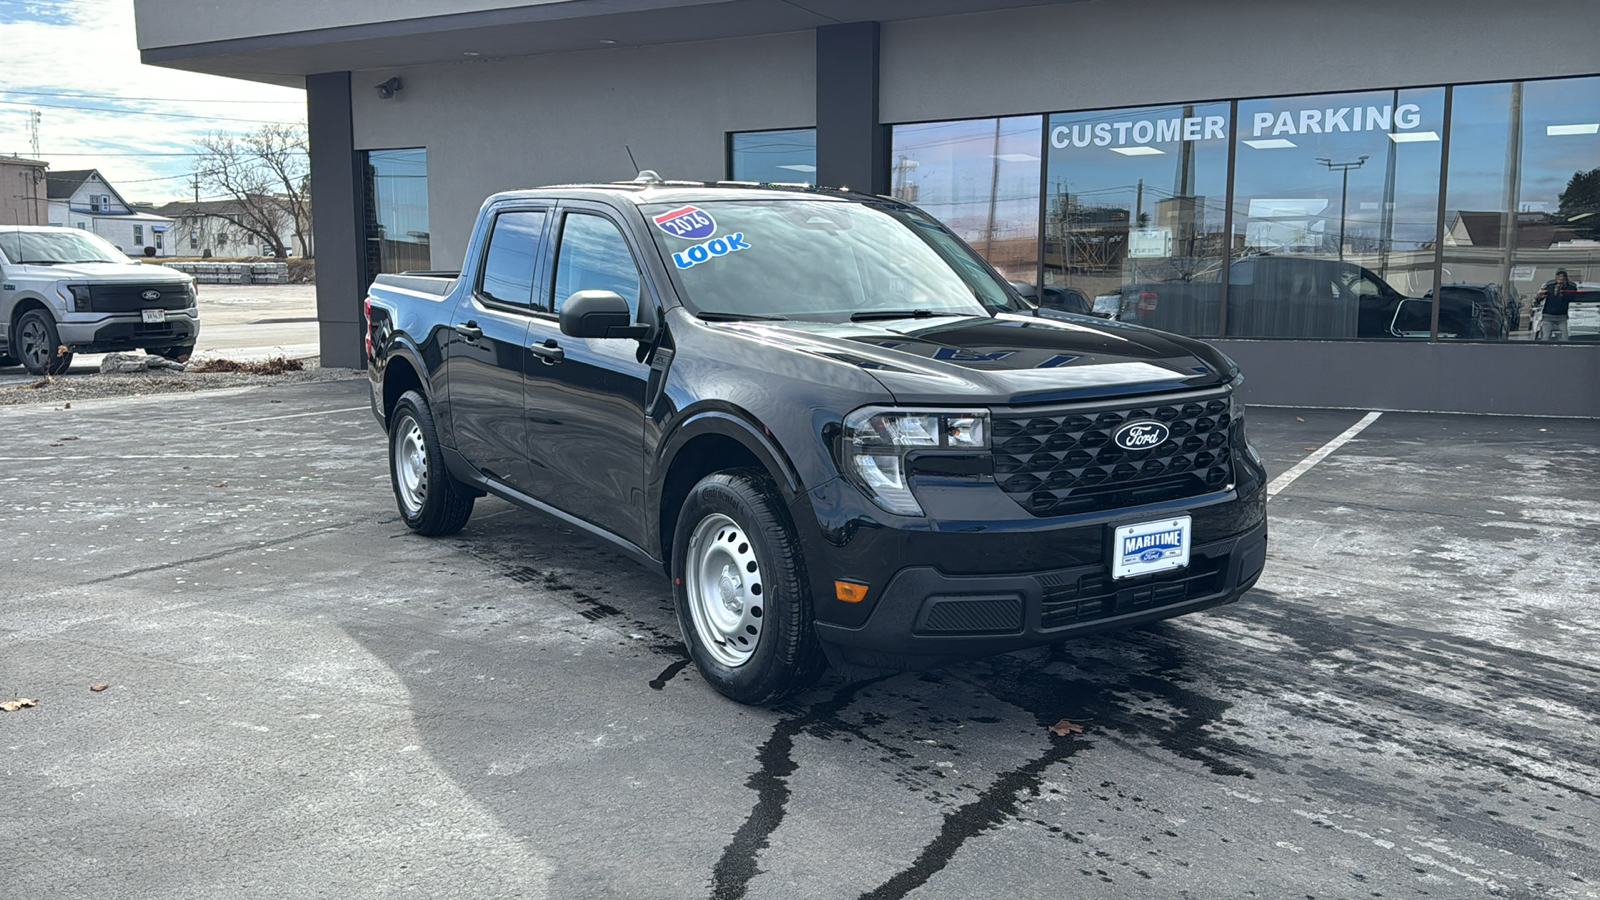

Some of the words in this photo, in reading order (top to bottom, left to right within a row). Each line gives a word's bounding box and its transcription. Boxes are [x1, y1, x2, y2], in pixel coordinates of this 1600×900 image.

[1051, 116, 1225, 149] CUSTOMER
[1253, 103, 1421, 137] PARKING
[666, 212, 710, 235] 2026
[673, 233, 750, 269] LOOK
[1125, 426, 1160, 446] Ford
[1125, 531, 1181, 555] MARITIME
[1143, 551, 1160, 561] Ford
